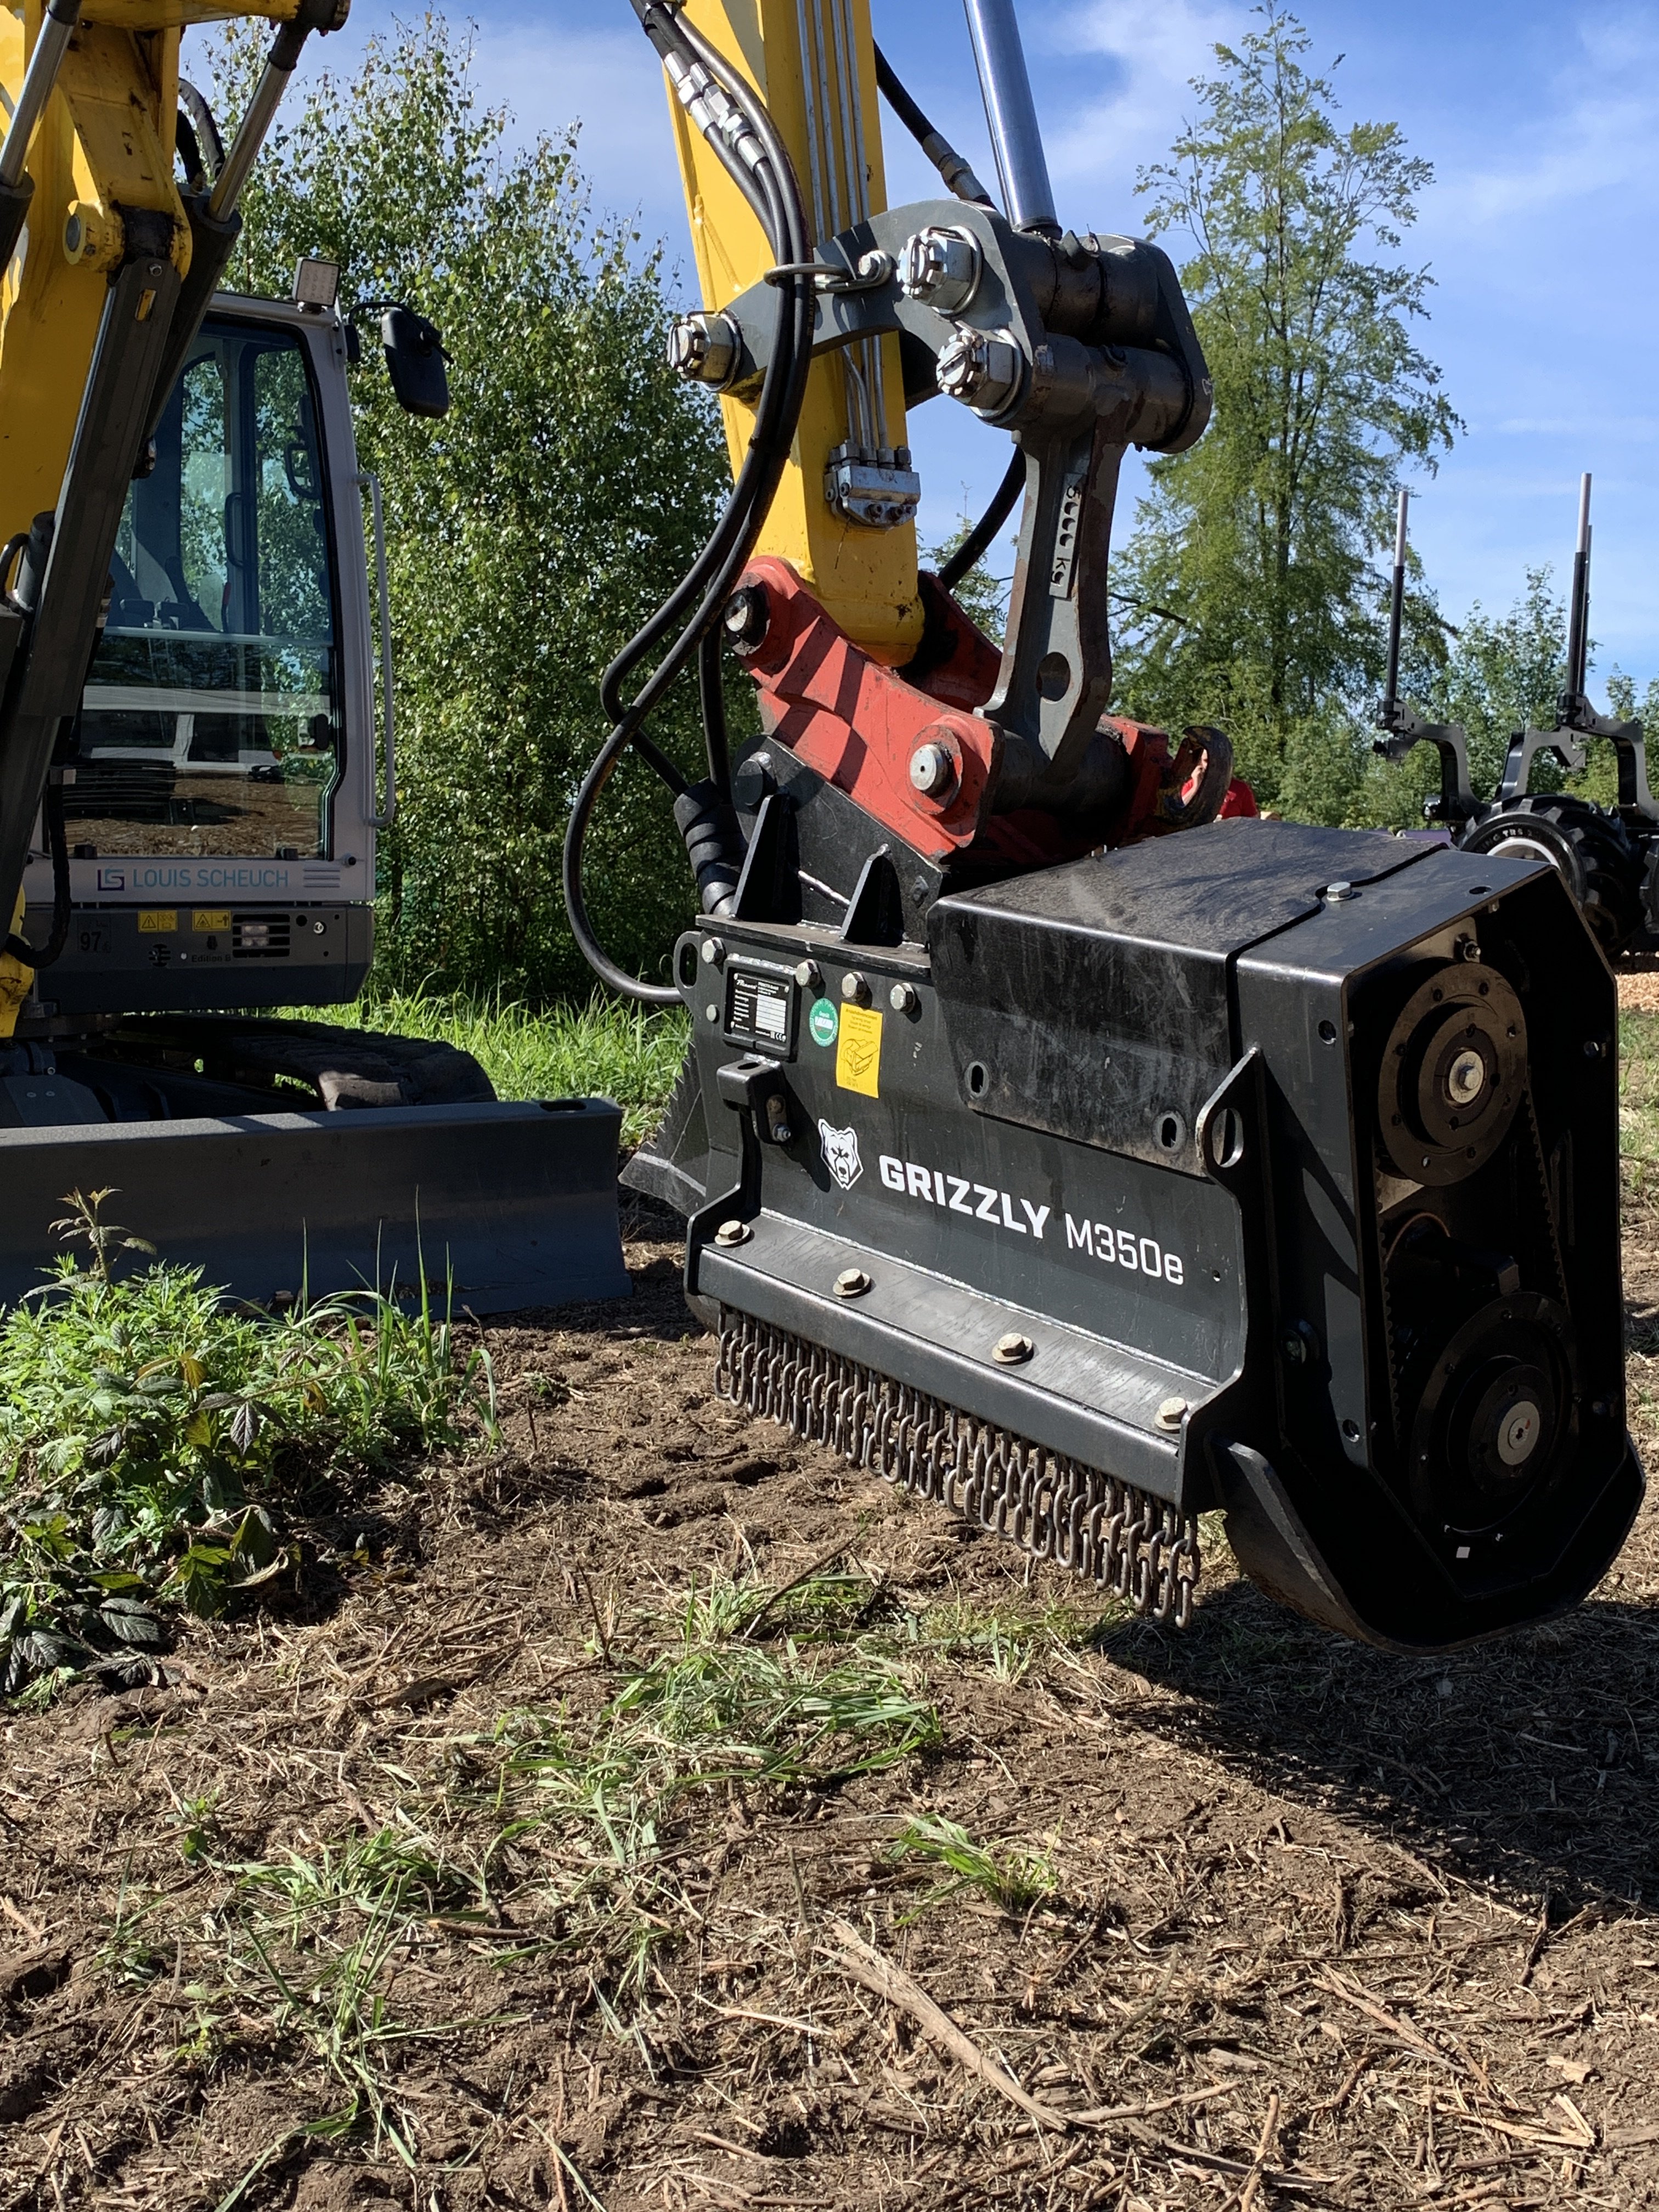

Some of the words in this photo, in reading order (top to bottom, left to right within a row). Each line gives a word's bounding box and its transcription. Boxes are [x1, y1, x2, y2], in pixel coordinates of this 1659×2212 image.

[1059, 485, 1081, 548] 5000
[1051, 557, 1071, 586] kg
[133, 869, 191, 888] LOUIS
[196, 869, 289, 888] SCHEUCH
[80, 931, 102, 952] 97
[191, 954, 223, 962] Edition
[878, 1154, 1051, 1239] GRIZZLY
[1065, 1212, 1183, 1285] M350e
